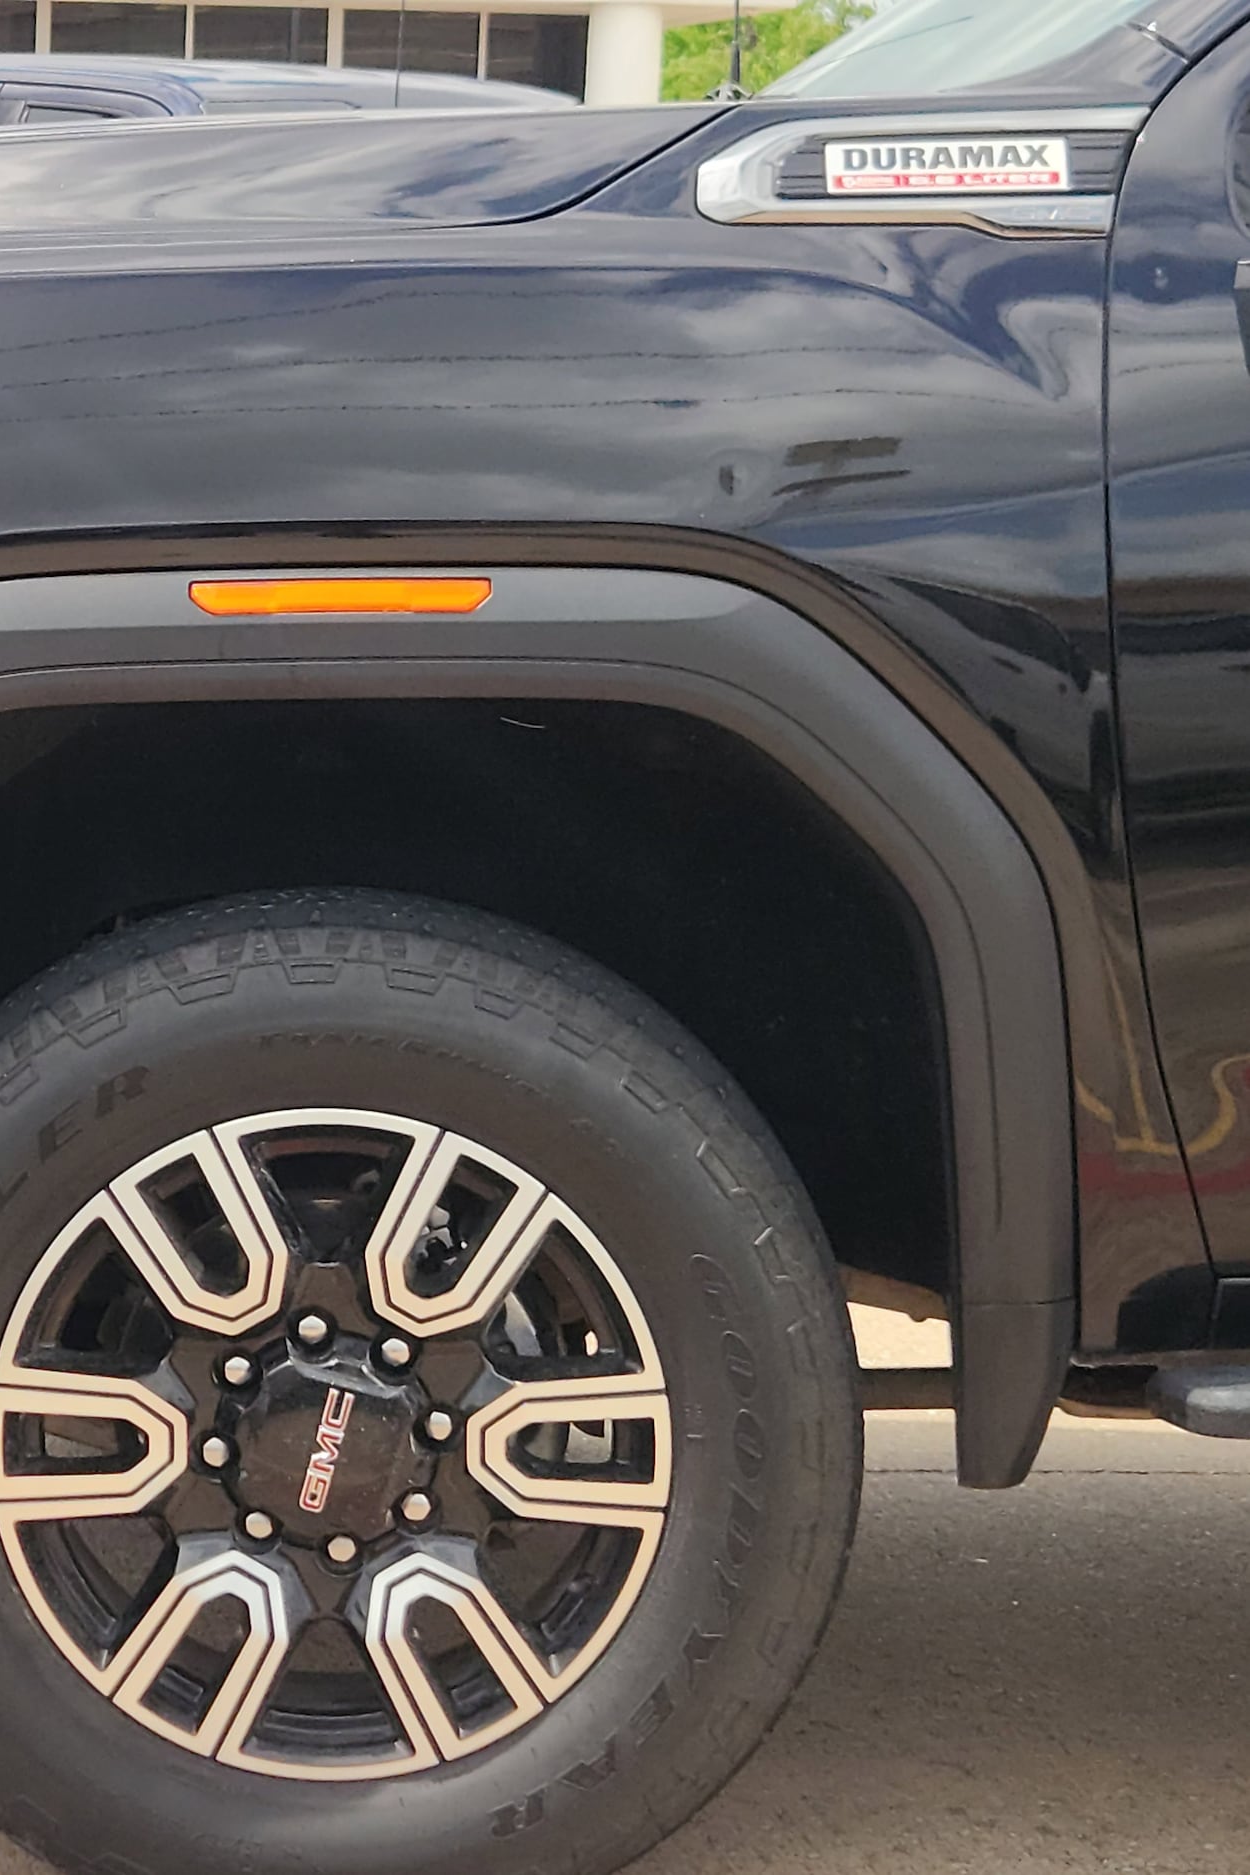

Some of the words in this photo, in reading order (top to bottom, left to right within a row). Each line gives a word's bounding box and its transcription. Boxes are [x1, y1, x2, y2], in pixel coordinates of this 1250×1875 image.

[841, 144, 1051, 171] DURAMAX
[299, 1387, 356, 1514] GMC
[488, 1252, 764, 1839] GOODYEAR
